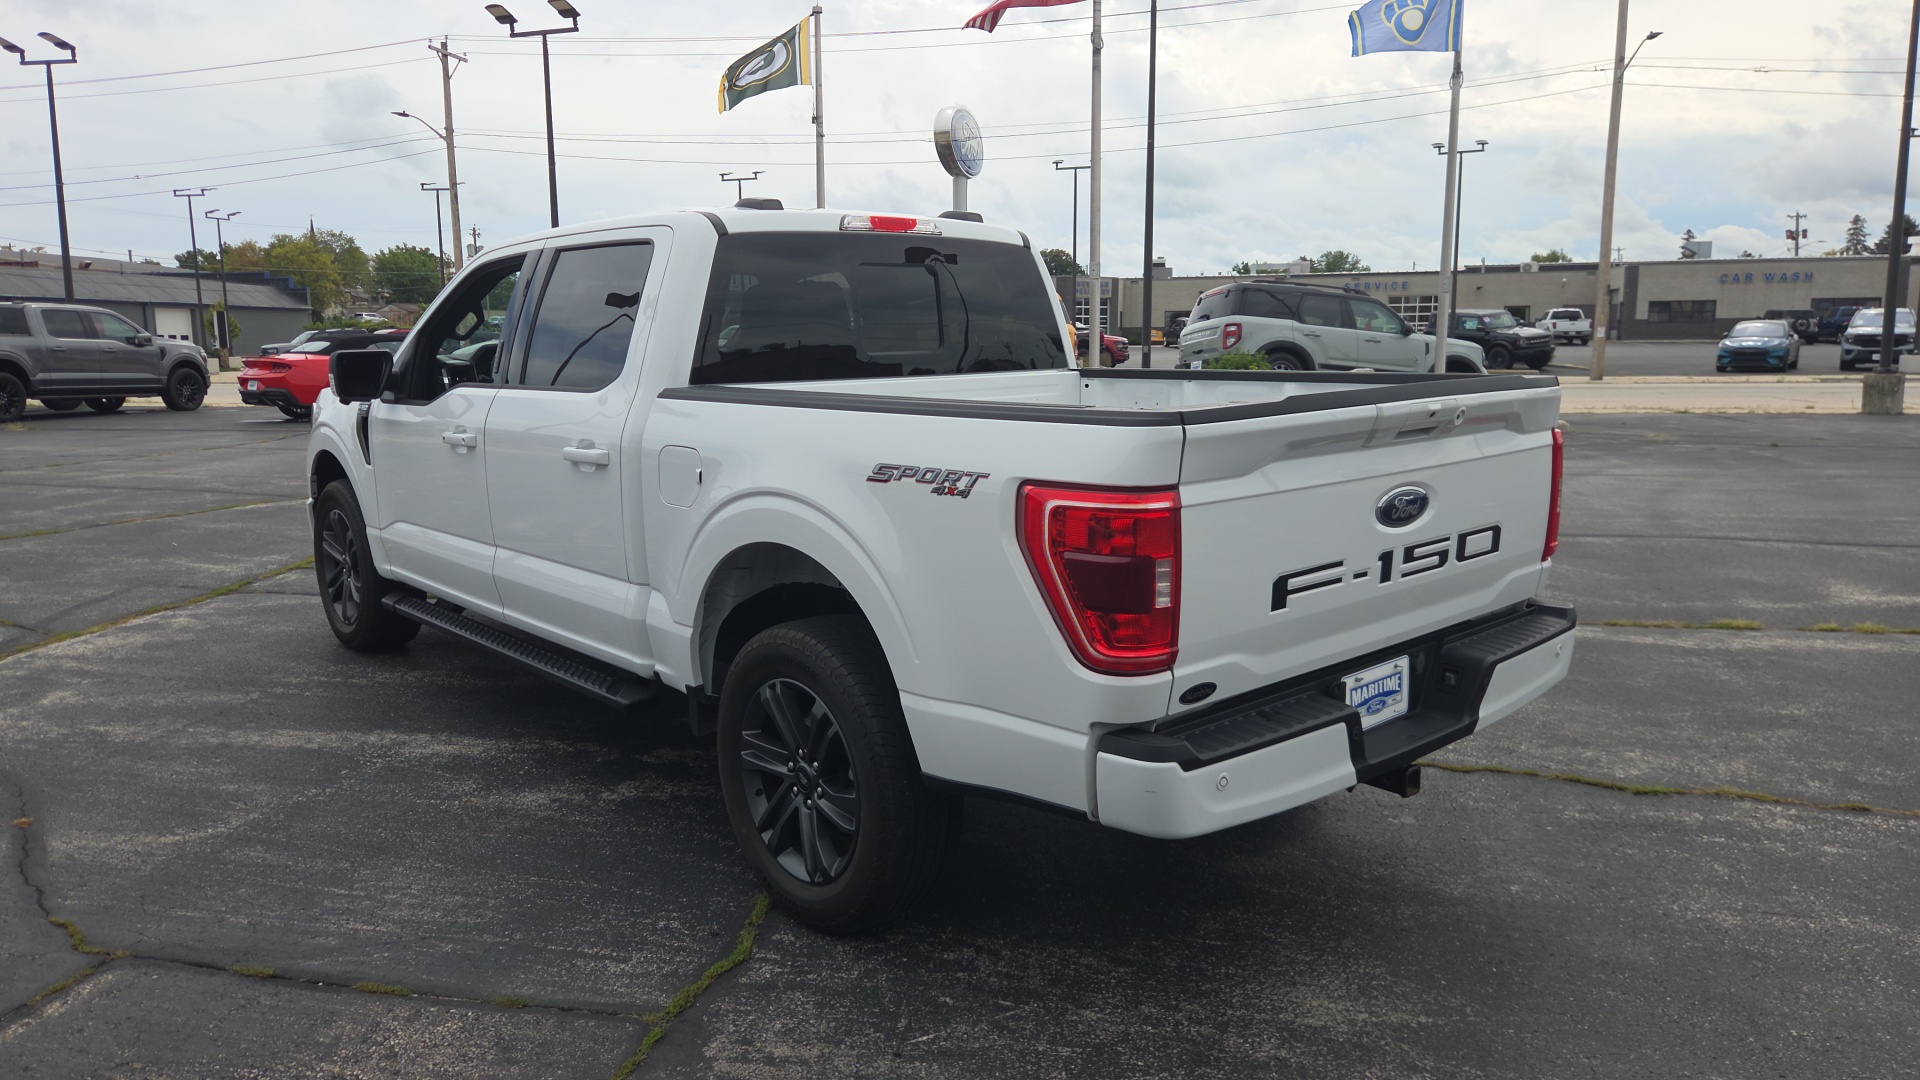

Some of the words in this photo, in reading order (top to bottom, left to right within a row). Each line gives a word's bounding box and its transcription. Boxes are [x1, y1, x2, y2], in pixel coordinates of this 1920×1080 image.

[1344, 281, 1409, 290] SERVICE
[1719, 272, 1753, 283] CAR
[1764, 271, 1814, 283] WASH
[866, 462, 991, 489] SPORT
[1391, 495, 1421, 520] Ford
[1270, 524, 1502, 613] F-150
[1351, 673, 1401, 707] MARITIME
